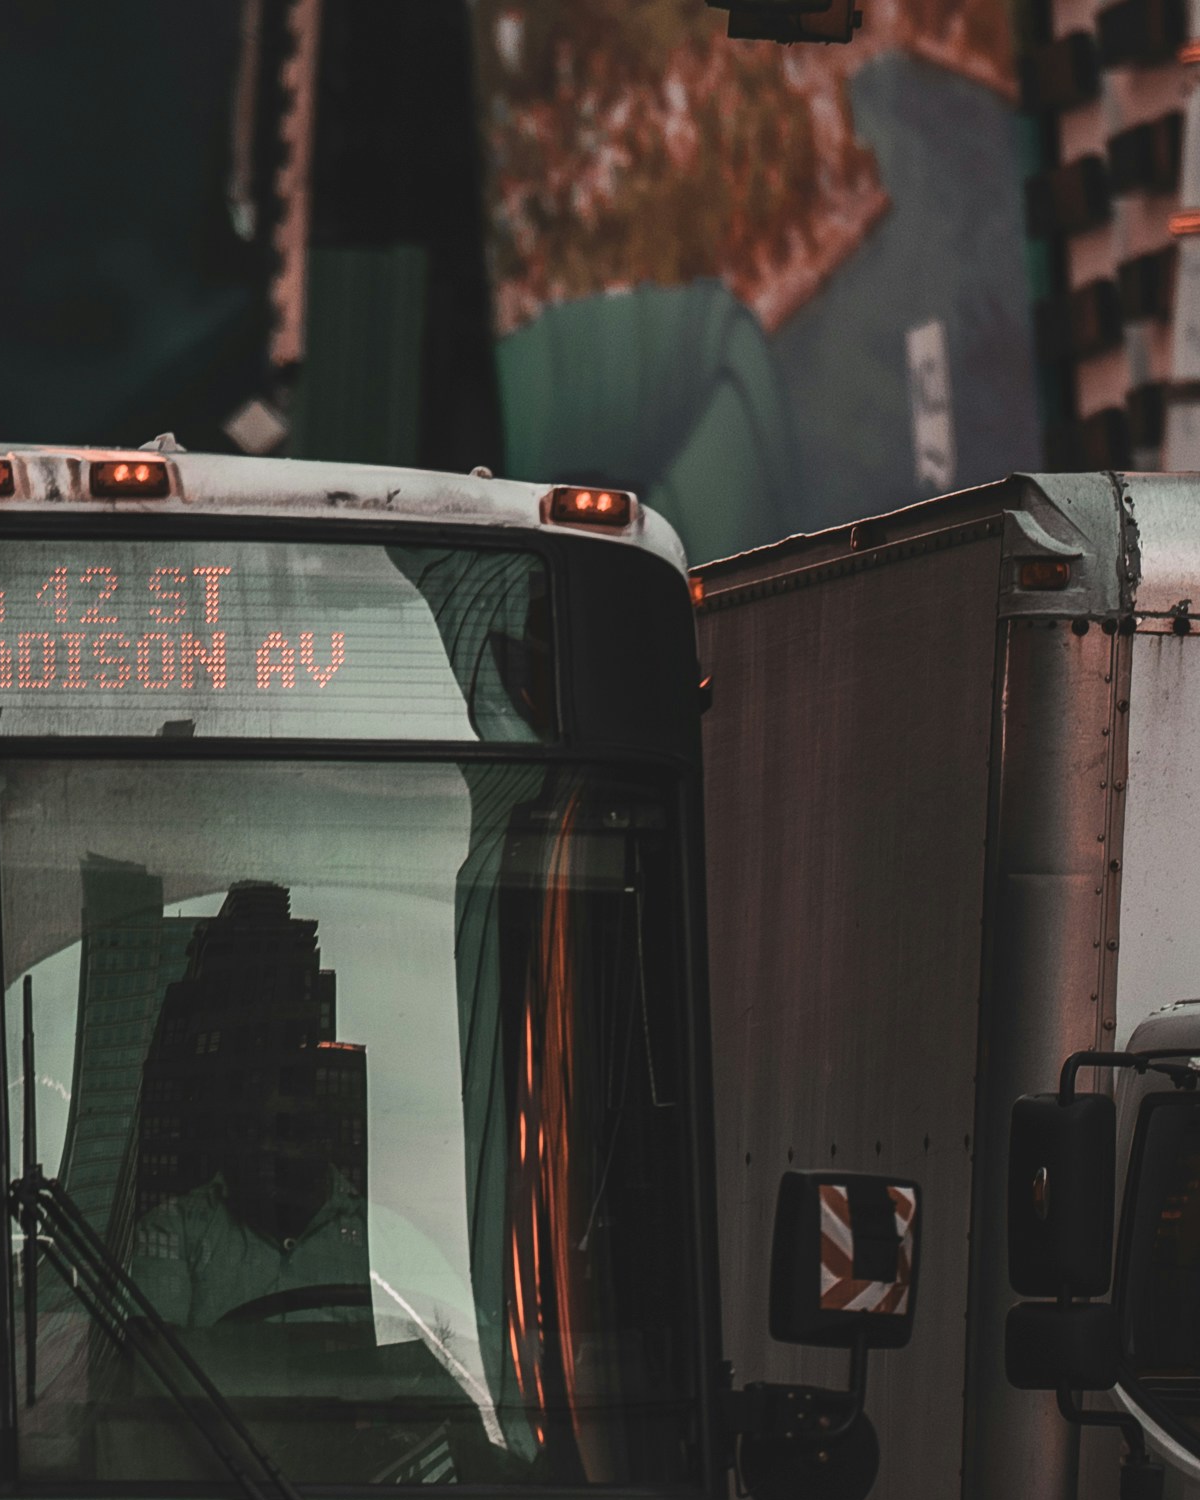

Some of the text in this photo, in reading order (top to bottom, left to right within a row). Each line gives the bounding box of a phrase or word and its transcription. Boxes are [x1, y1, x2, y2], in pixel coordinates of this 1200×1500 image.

[36, 566, 119, 624] 42
[149, 566, 232, 624] ST
[256, 631, 346, 688] AV
